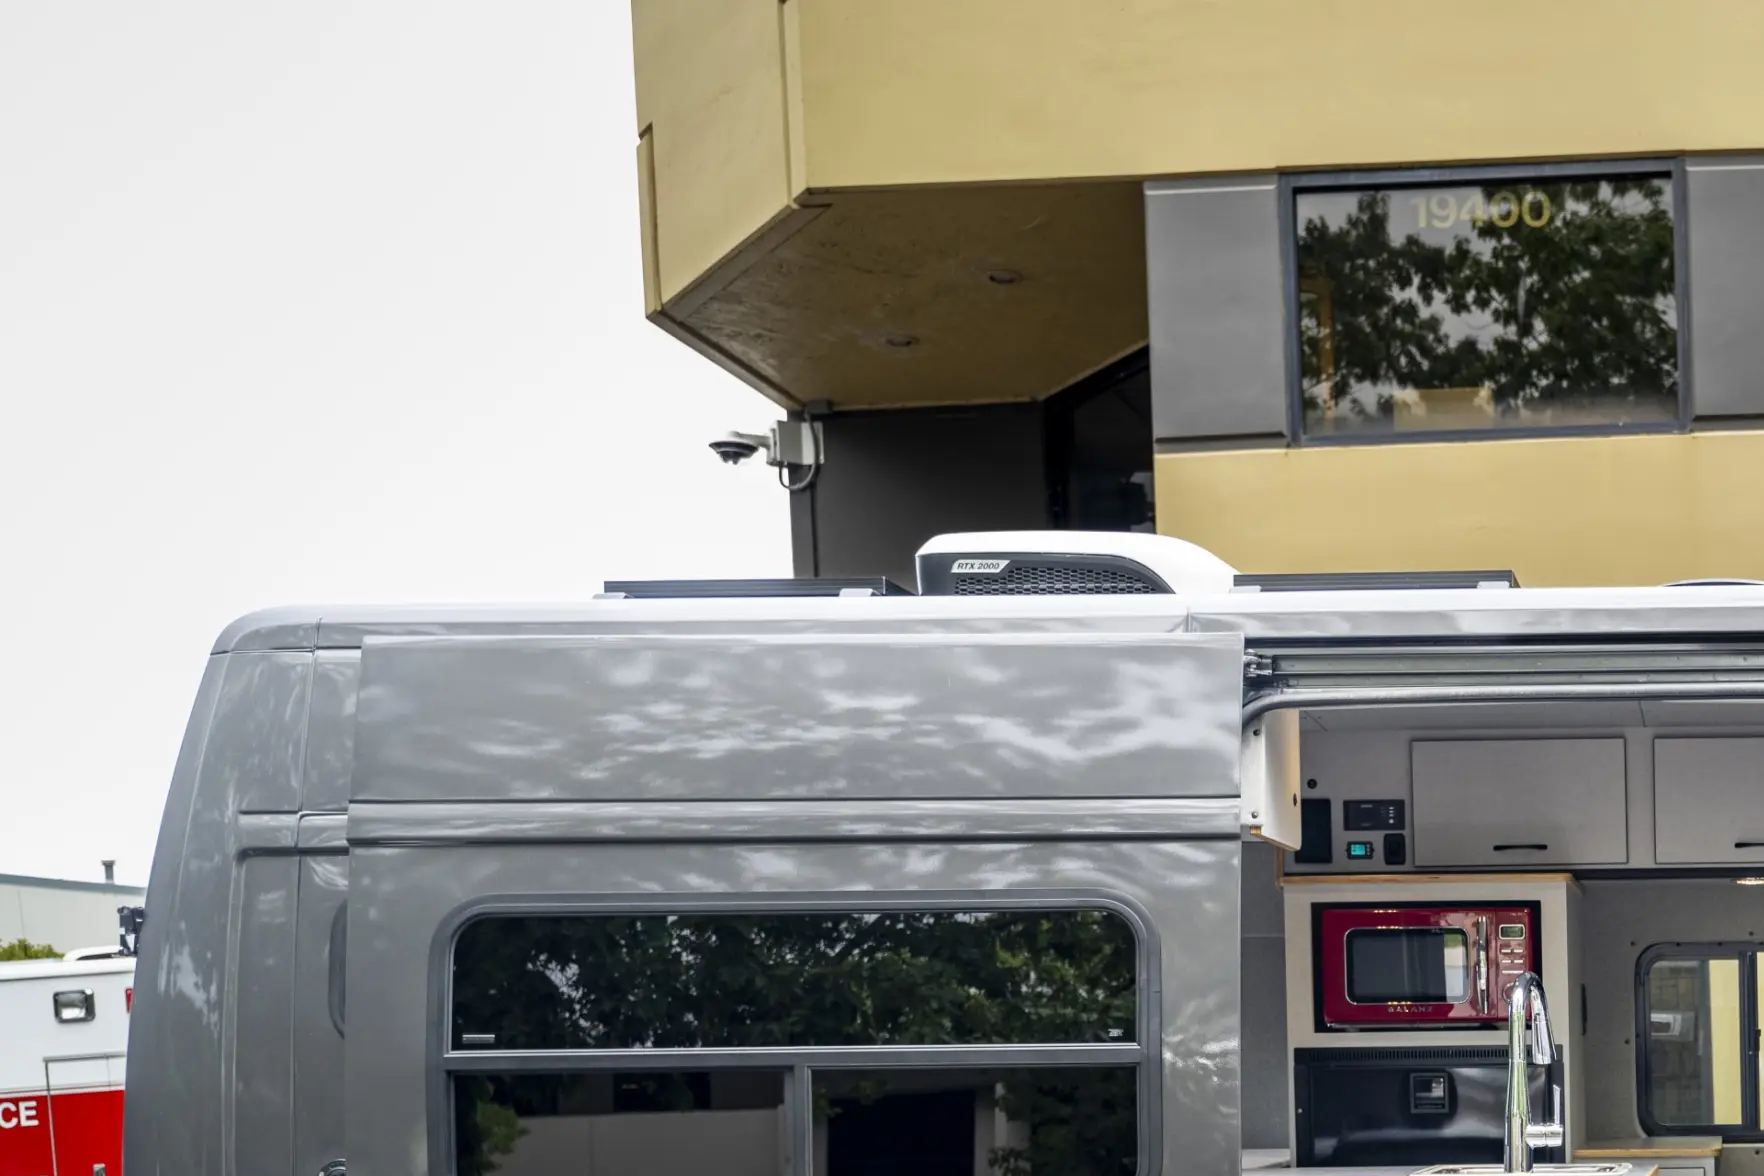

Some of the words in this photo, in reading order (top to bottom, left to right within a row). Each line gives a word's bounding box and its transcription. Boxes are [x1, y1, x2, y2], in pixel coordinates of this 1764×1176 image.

[1411, 191, 1552, 229] 19400
[957, 562, 976, 570] RTX
[978, 562, 1000, 570] 2000
